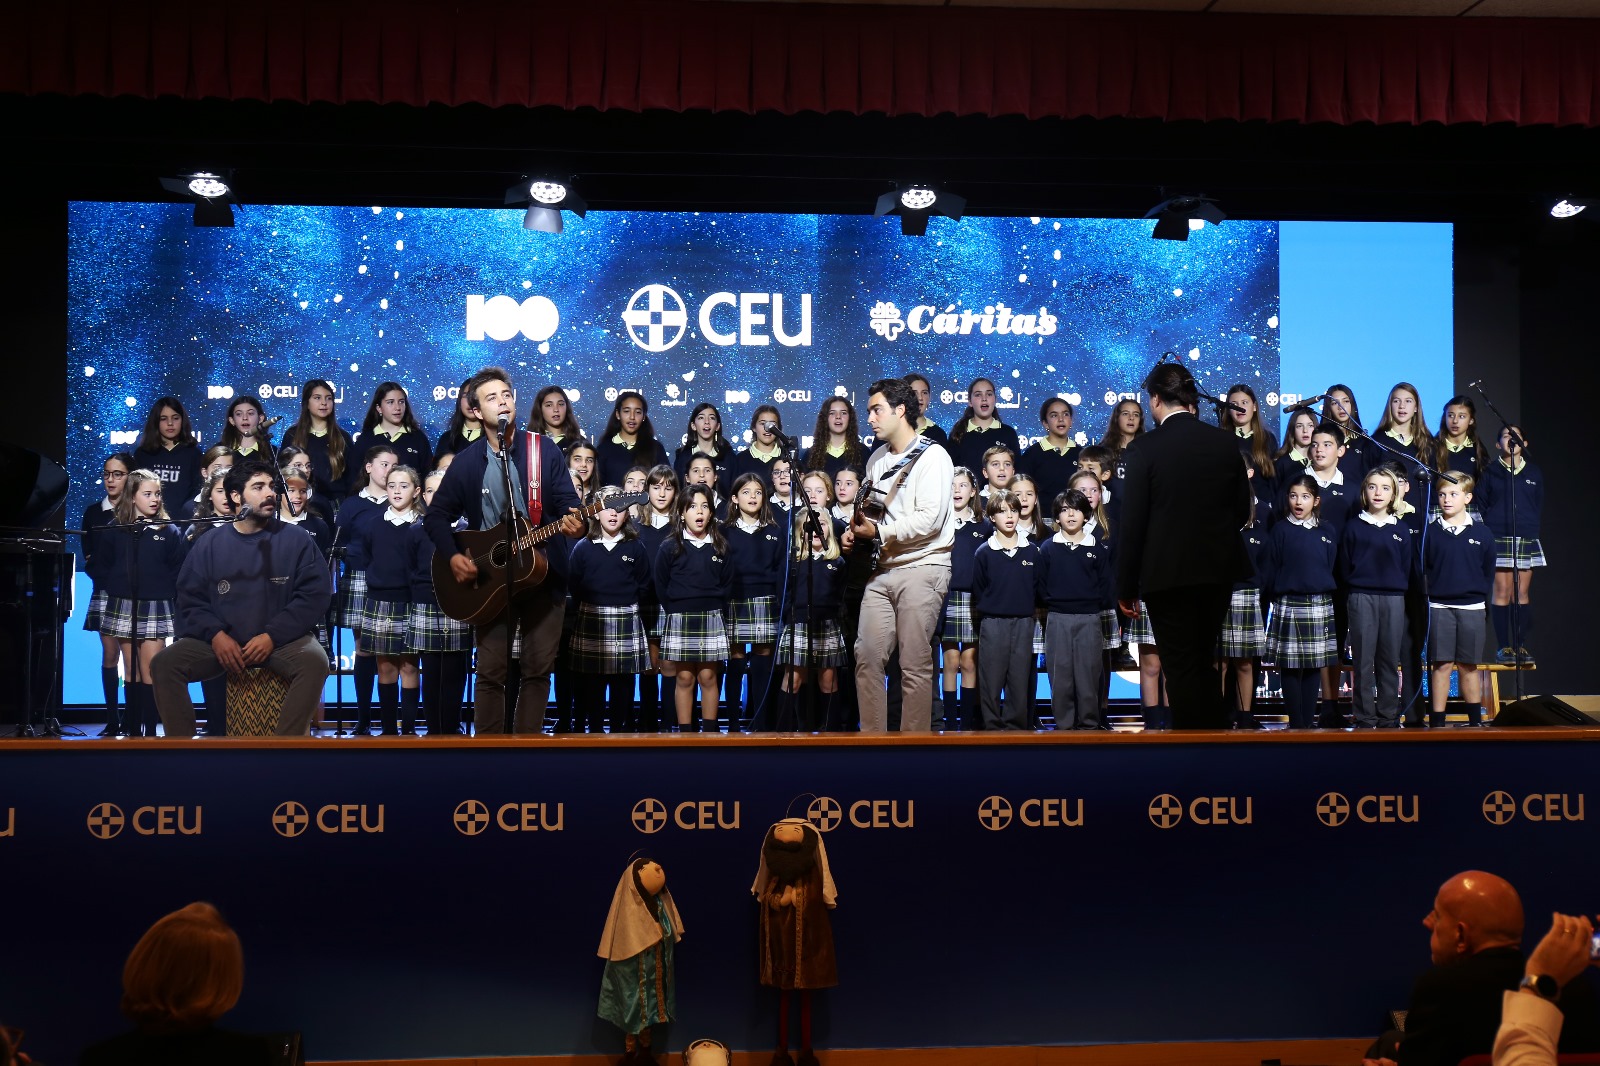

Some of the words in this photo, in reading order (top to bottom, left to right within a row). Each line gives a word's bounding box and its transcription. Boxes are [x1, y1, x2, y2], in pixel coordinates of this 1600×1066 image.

[466, 294, 560, 342] 100
[699, 291, 812, 347] CEU
[907, 303, 1058, 336] Cáritas
[273, 385, 298, 398] CEU
[787, 389, 812, 402] CEU
[132, 805, 203, 836] CEU
[316, 803, 385, 834] CEU
[495, 802, 565, 833] CEU
[673, 800, 741, 831] CEU
[848, 799, 915, 829] CEU
[1019, 798, 1085, 828] CEU
[1188, 796, 1253, 826] CEU
[1356, 794, 1420, 824] CEU
[1522, 793, 1585, 822] CEU
